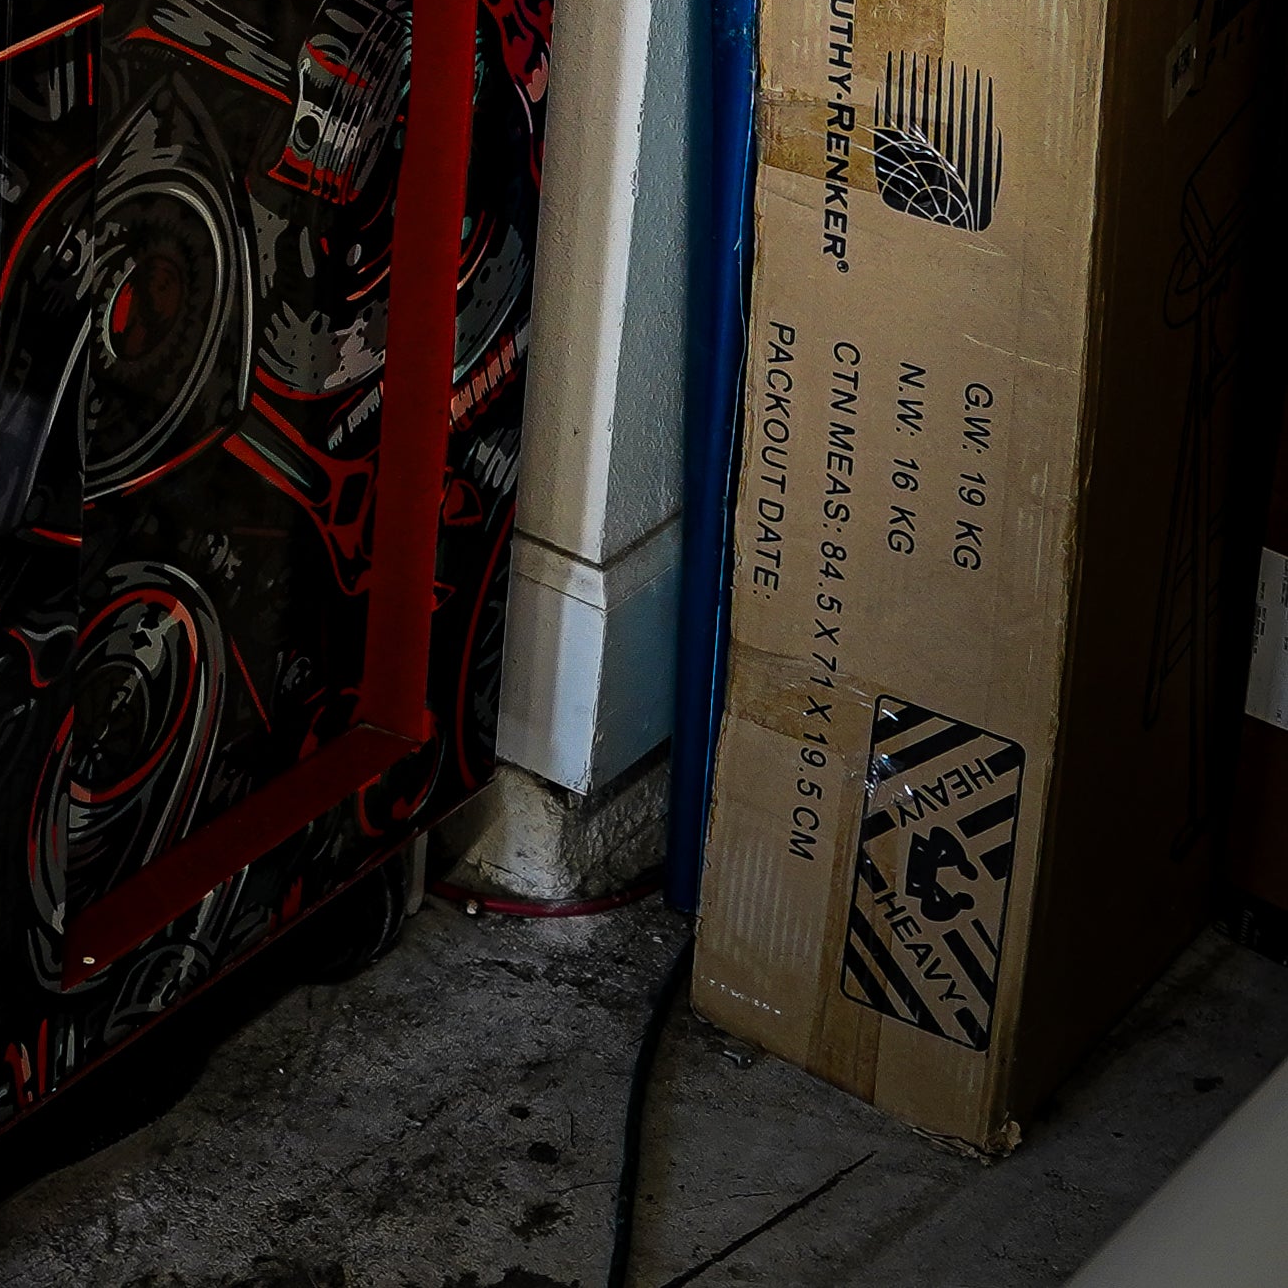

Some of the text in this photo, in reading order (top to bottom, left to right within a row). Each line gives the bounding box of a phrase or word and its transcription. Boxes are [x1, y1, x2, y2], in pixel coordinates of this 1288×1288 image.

[753, 321, 796, 600] PACKOUT DATE:
[887, 362, 927, 556] N.W: 16 KG
[953, 383, 994, 571] G.W: 19 KG
[788, 341, 861, 861] CTN MEAS: 84.5 X 71 X 19.5 CM
[895, 757, 996, 828] HEAVY
[874, 890, 968, 1003] HEAVY
